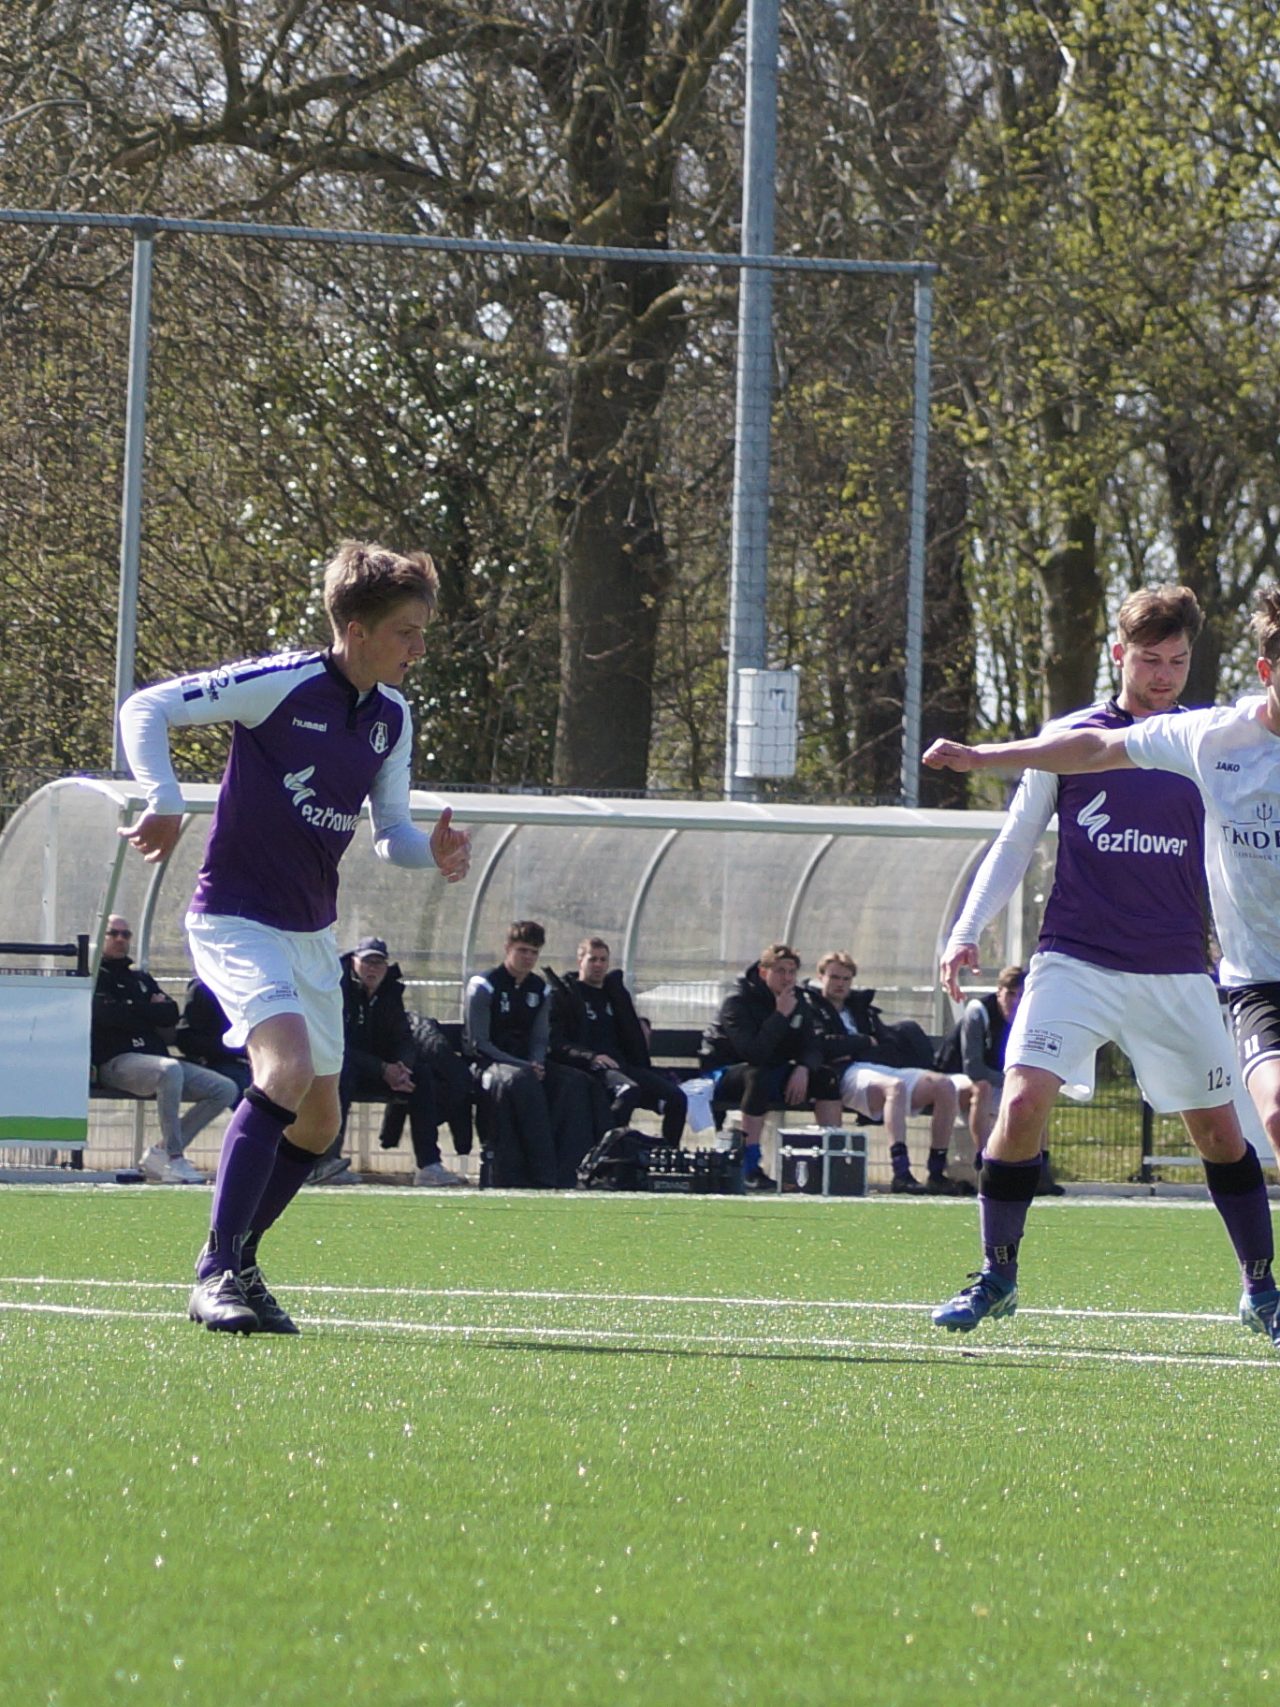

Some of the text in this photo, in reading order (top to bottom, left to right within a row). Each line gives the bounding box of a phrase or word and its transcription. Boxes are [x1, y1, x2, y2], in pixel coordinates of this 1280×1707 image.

[1215, 761, 1240, 772] JAKO
[1097, 828, 1188, 857] ezflower
[1244, 1034, 1260, 1060] 11
[1207, 1066, 1223, 1091] 12
